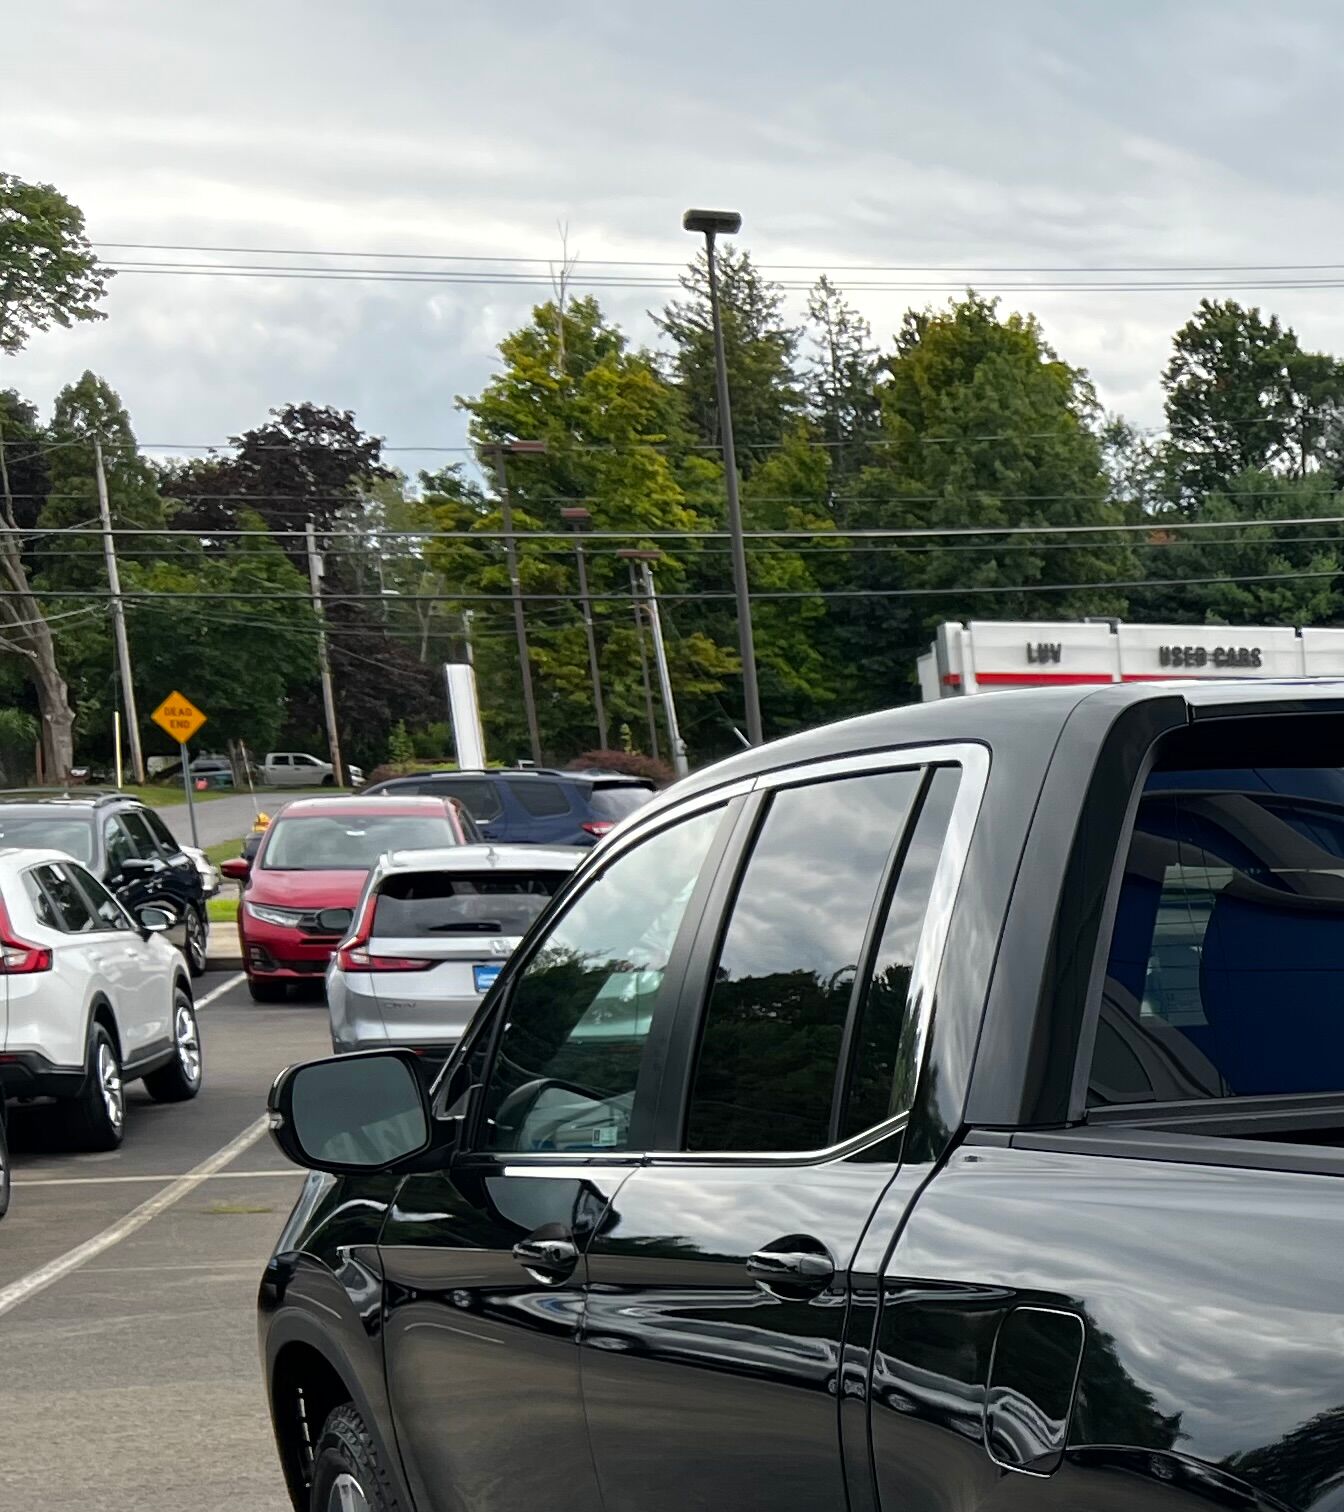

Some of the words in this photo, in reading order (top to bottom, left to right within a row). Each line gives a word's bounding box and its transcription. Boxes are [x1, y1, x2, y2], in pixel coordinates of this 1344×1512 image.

[1026, 642, 1062, 665] LUV
[1158, 645, 1208, 668] USED
[1214, 646, 1262, 669] CARS
[164, 707, 193, 717] DEAD
[170, 719, 191, 729] END
